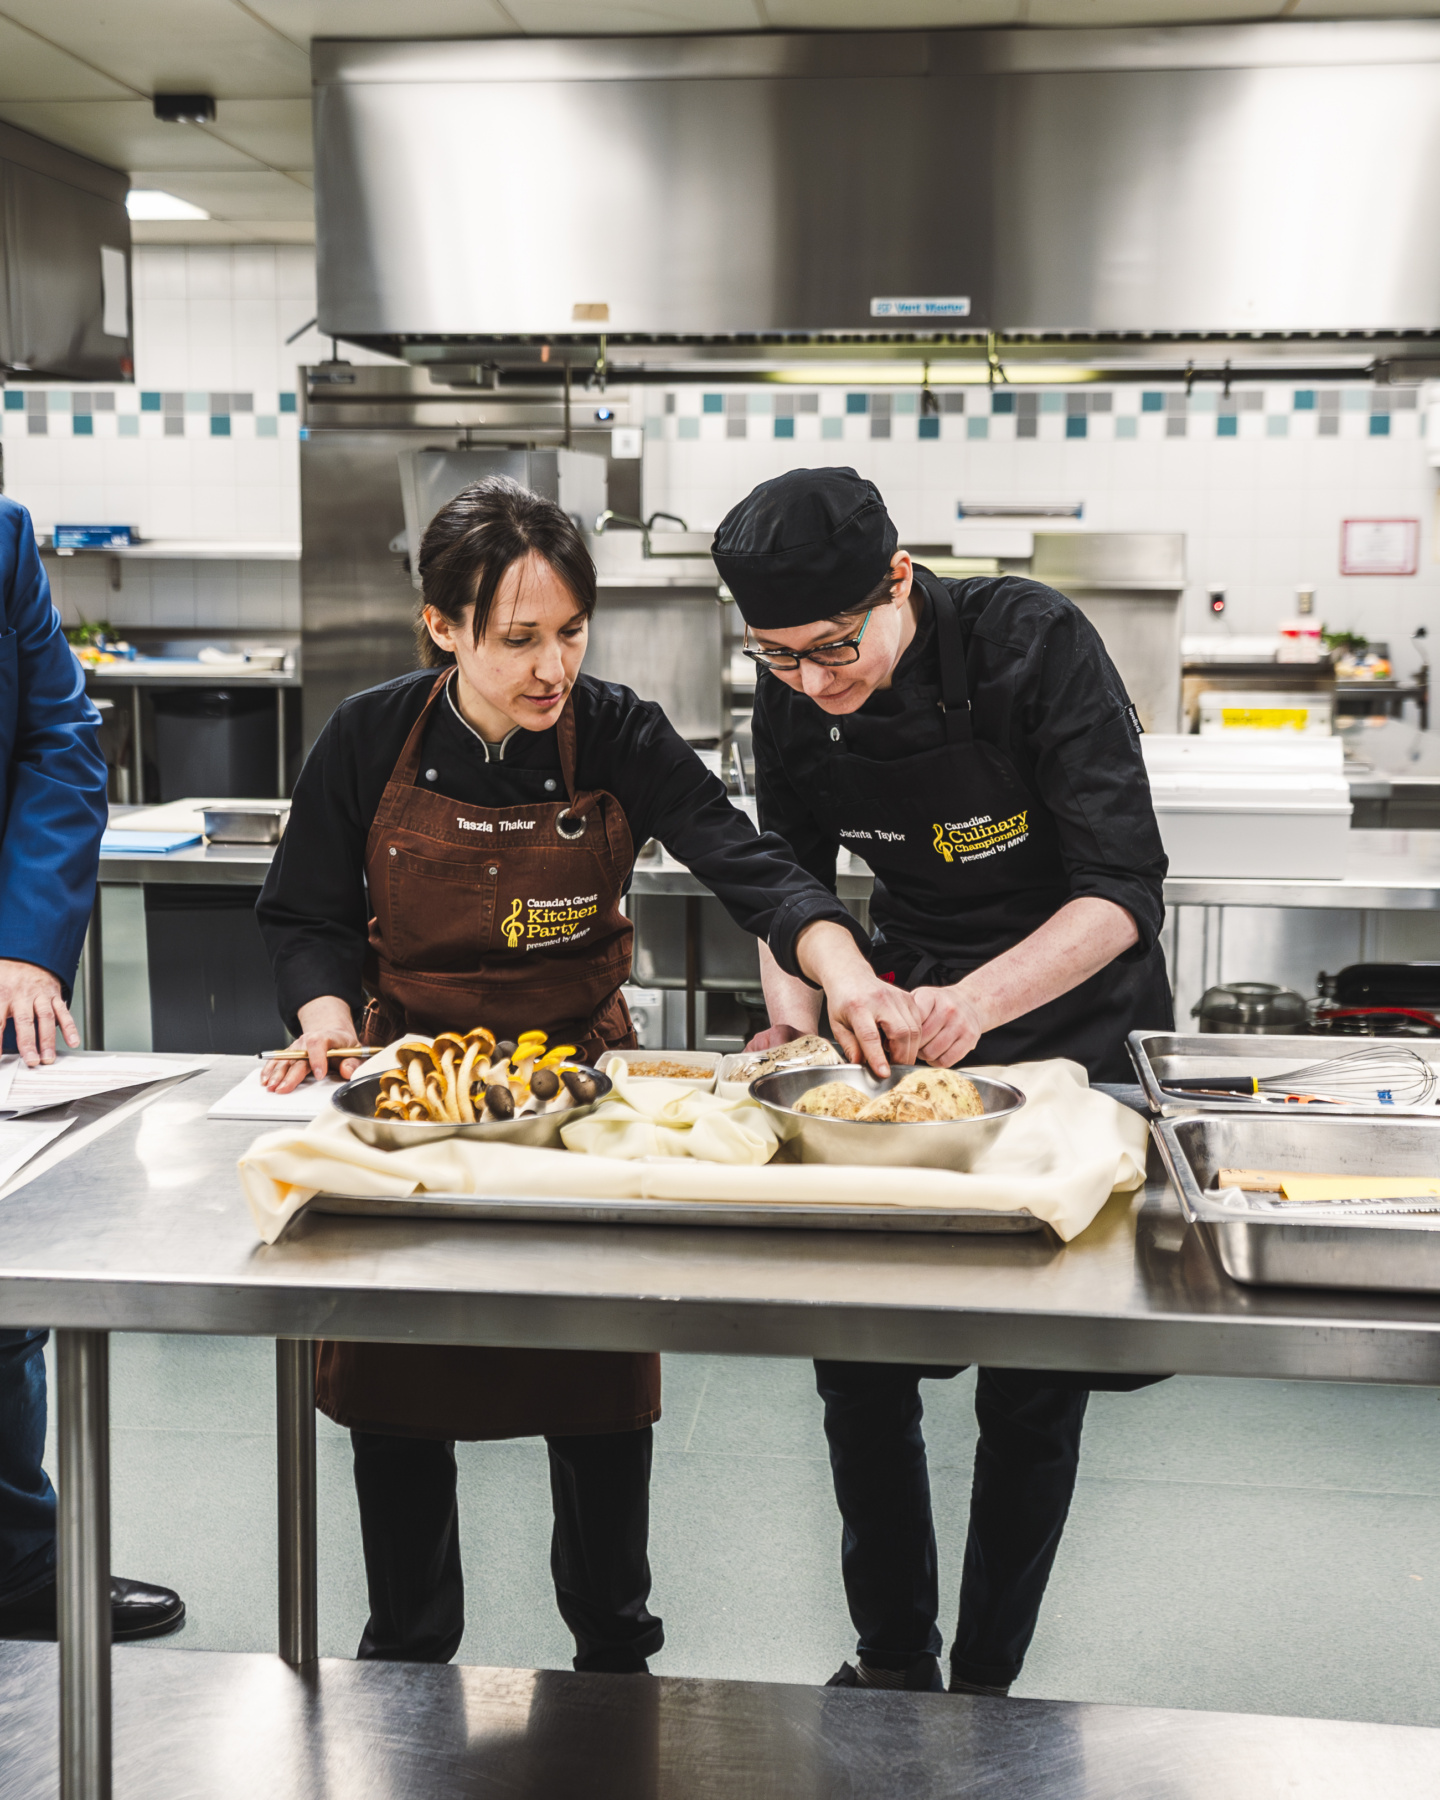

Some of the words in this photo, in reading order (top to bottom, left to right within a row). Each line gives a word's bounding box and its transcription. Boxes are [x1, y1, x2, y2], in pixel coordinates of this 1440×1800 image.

[498, 819, 536, 832] Thakur
[944, 814, 992, 831] Canadian
[948, 810, 1028, 844] Culinary
[874, 829, 906, 842] Taylor
[954, 823, 1029, 853] Championship
[960, 846, 997, 864] presented
[996, 843, 1007, 852] by
[526, 897, 572, 908] Canada's
[572, 893, 598, 905] Great
[527, 904, 598, 923] Kitchen
[526, 922, 579, 938] Party
[526, 937, 561, 951] presented
